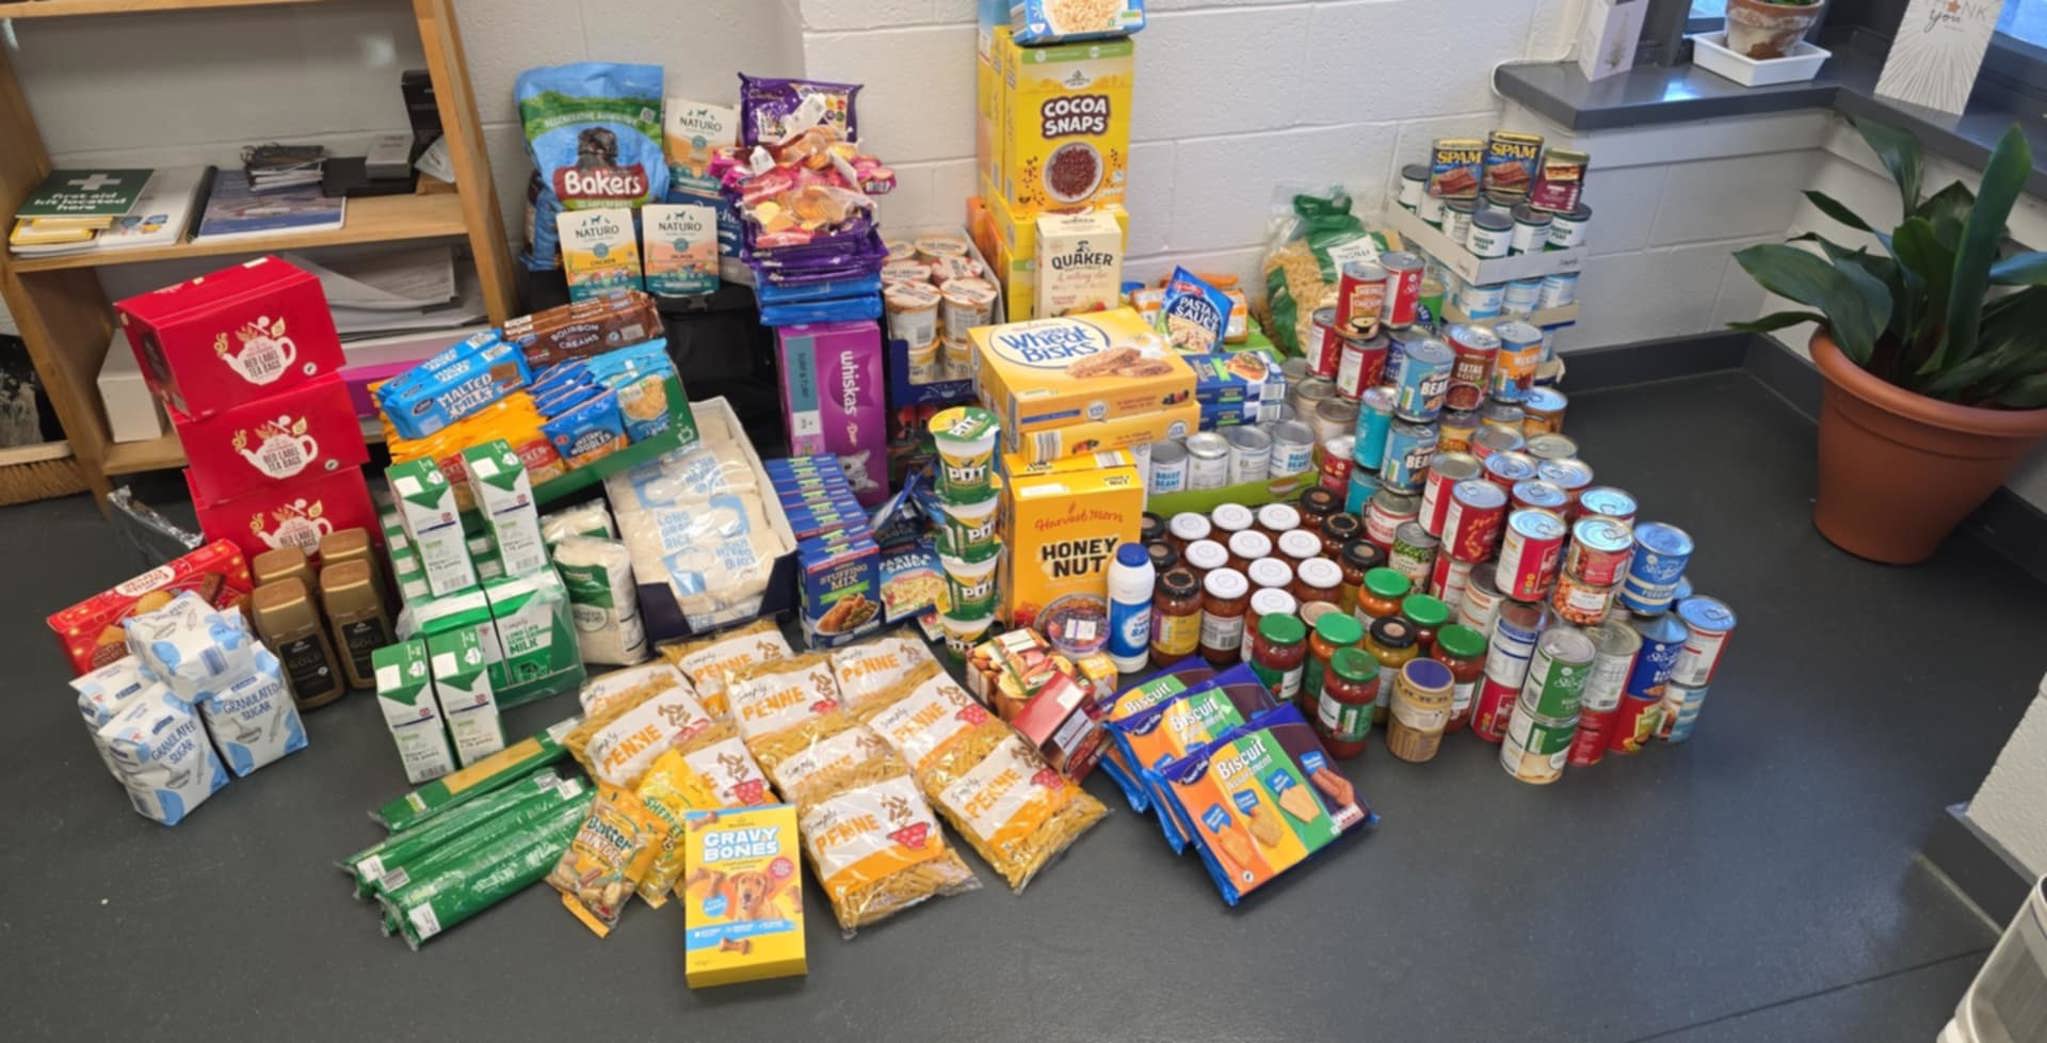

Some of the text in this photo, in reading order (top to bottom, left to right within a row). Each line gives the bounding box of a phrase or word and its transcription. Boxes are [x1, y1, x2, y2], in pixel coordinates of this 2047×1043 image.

[1044, 98, 1107, 117] COCOA
[680, 118, 722, 133] NATURO
[1045, 117, 1105, 136] SNAPS
[1437, 151, 1483, 164] SPAM
[1491, 143, 1537, 159] SPAM
[564, 170, 641, 196] Bakers
[575, 226, 620, 239] NATURO
[659, 221, 702, 232] NATURO
[1052, 252, 1113, 270] QUAKER
[551, 324, 599, 341] BOURBON
[559, 334, 599, 349] CREAMS
[998, 326, 1095, 350] Wheat
[438, 373, 492, 408] MALTED
[840, 350, 861, 416] whiskas
[1042, 537, 1119, 562] HONEY
[1053, 555, 1107, 577] NUT
[831, 574, 858, 590] MIX
[841, 654, 900, 683] PENNE
[222, 681, 280, 714] GRANULATED
[742, 686, 806, 721] PENNE
[1124, 682, 1172, 715] Biscuit
[240, 700, 272, 721] SUGAR
[892, 701, 947, 741] PENNE
[1169, 693, 1219, 733] Biscuit
[168, 739, 196, 765] SUGAR
[602, 724, 663, 775] PENNE
[1216, 737, 1267, 780] Biscuit
[964, 768, 1022, 819] PENNE
[587, 814, 632, 850] Butter
[704, 826, 779, 848] GRAVY
[815, 813, 881, 853] PENNE
[704, 842, 778, 863] BONES
